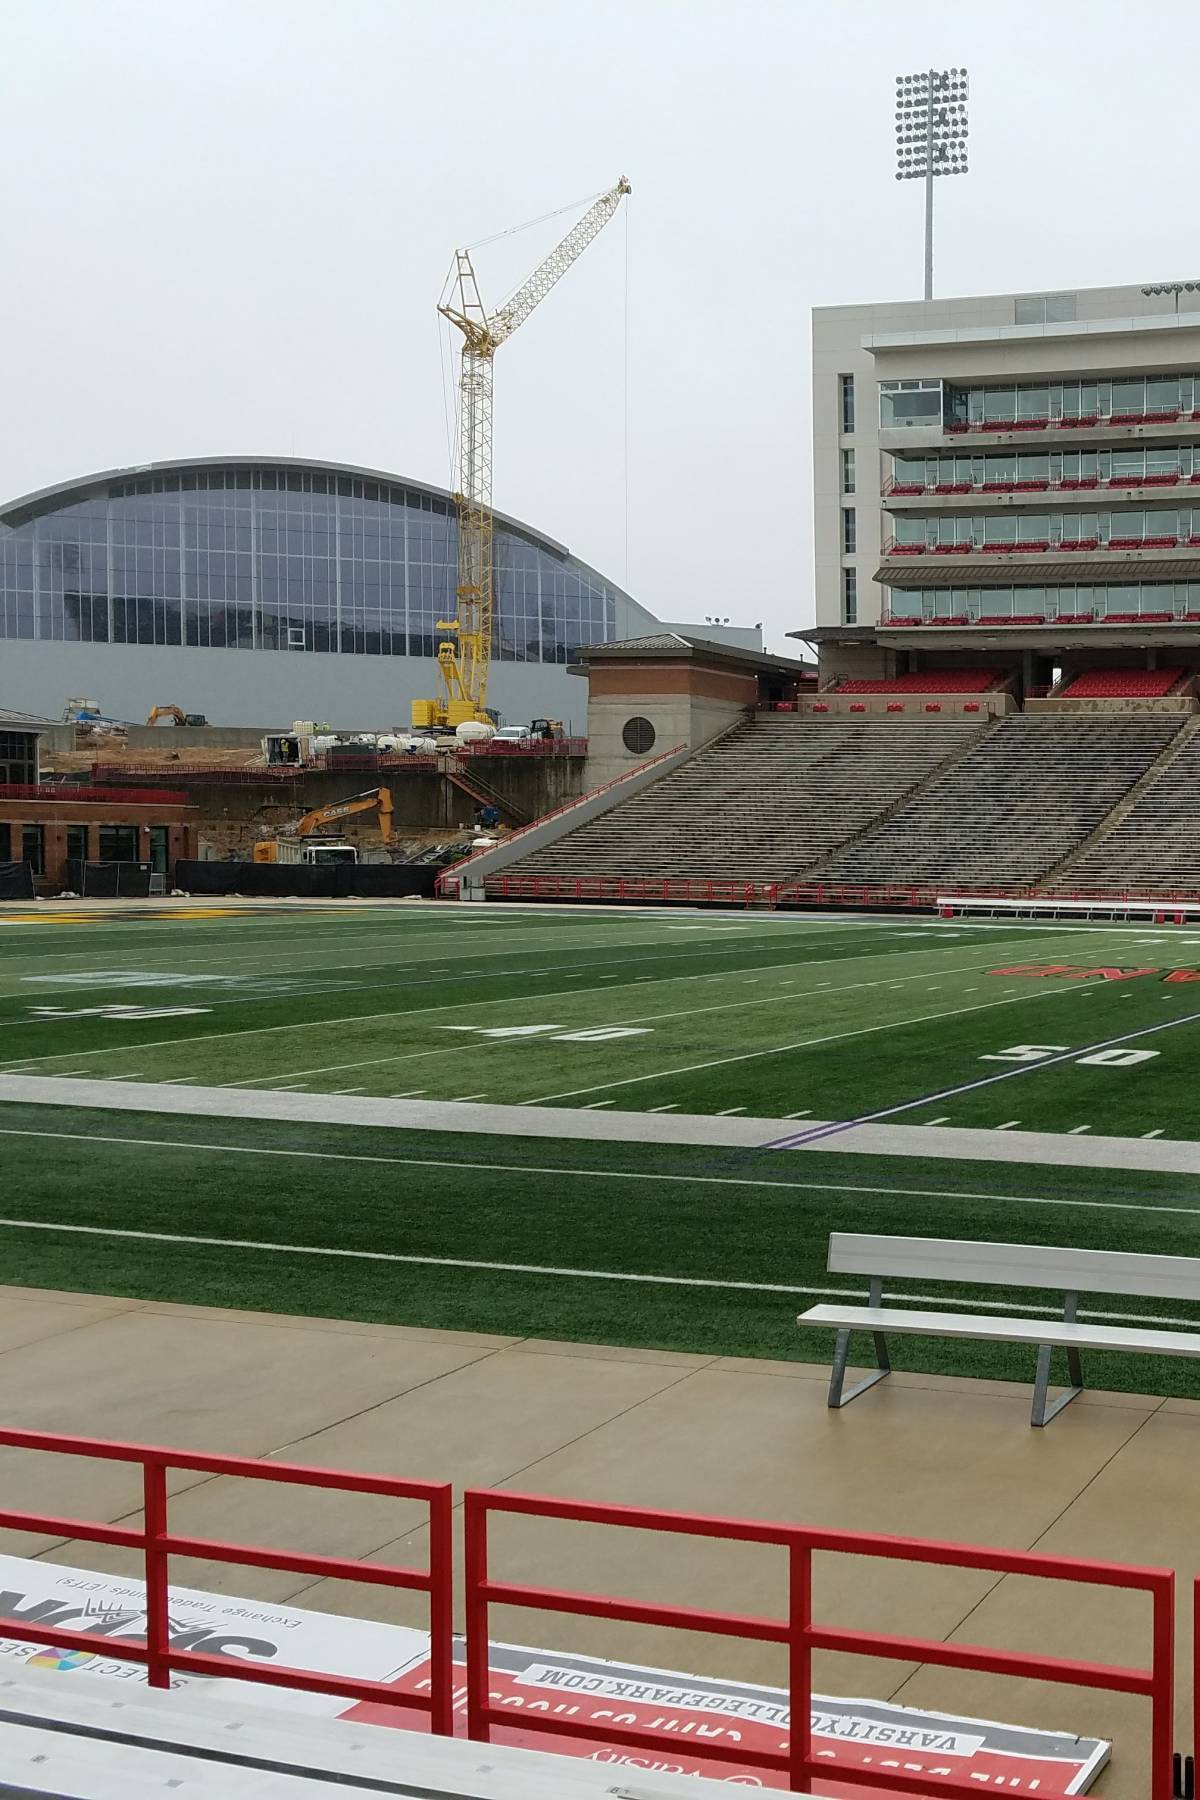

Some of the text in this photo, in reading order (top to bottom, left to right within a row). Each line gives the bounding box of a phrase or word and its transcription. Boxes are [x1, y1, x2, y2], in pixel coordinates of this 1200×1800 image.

[323, 806, 350, 818] CASE
[471, 1024, 656, 1042] 40
[978, 1044, 1162, 1066] 50
[55, 1576, 109, 1591] (ETFs)
[109, 1584, 148, 1601] unds
[221, 1606, 304, 1629] Exchange
[82, 1656, 189, 1690] SLECT
